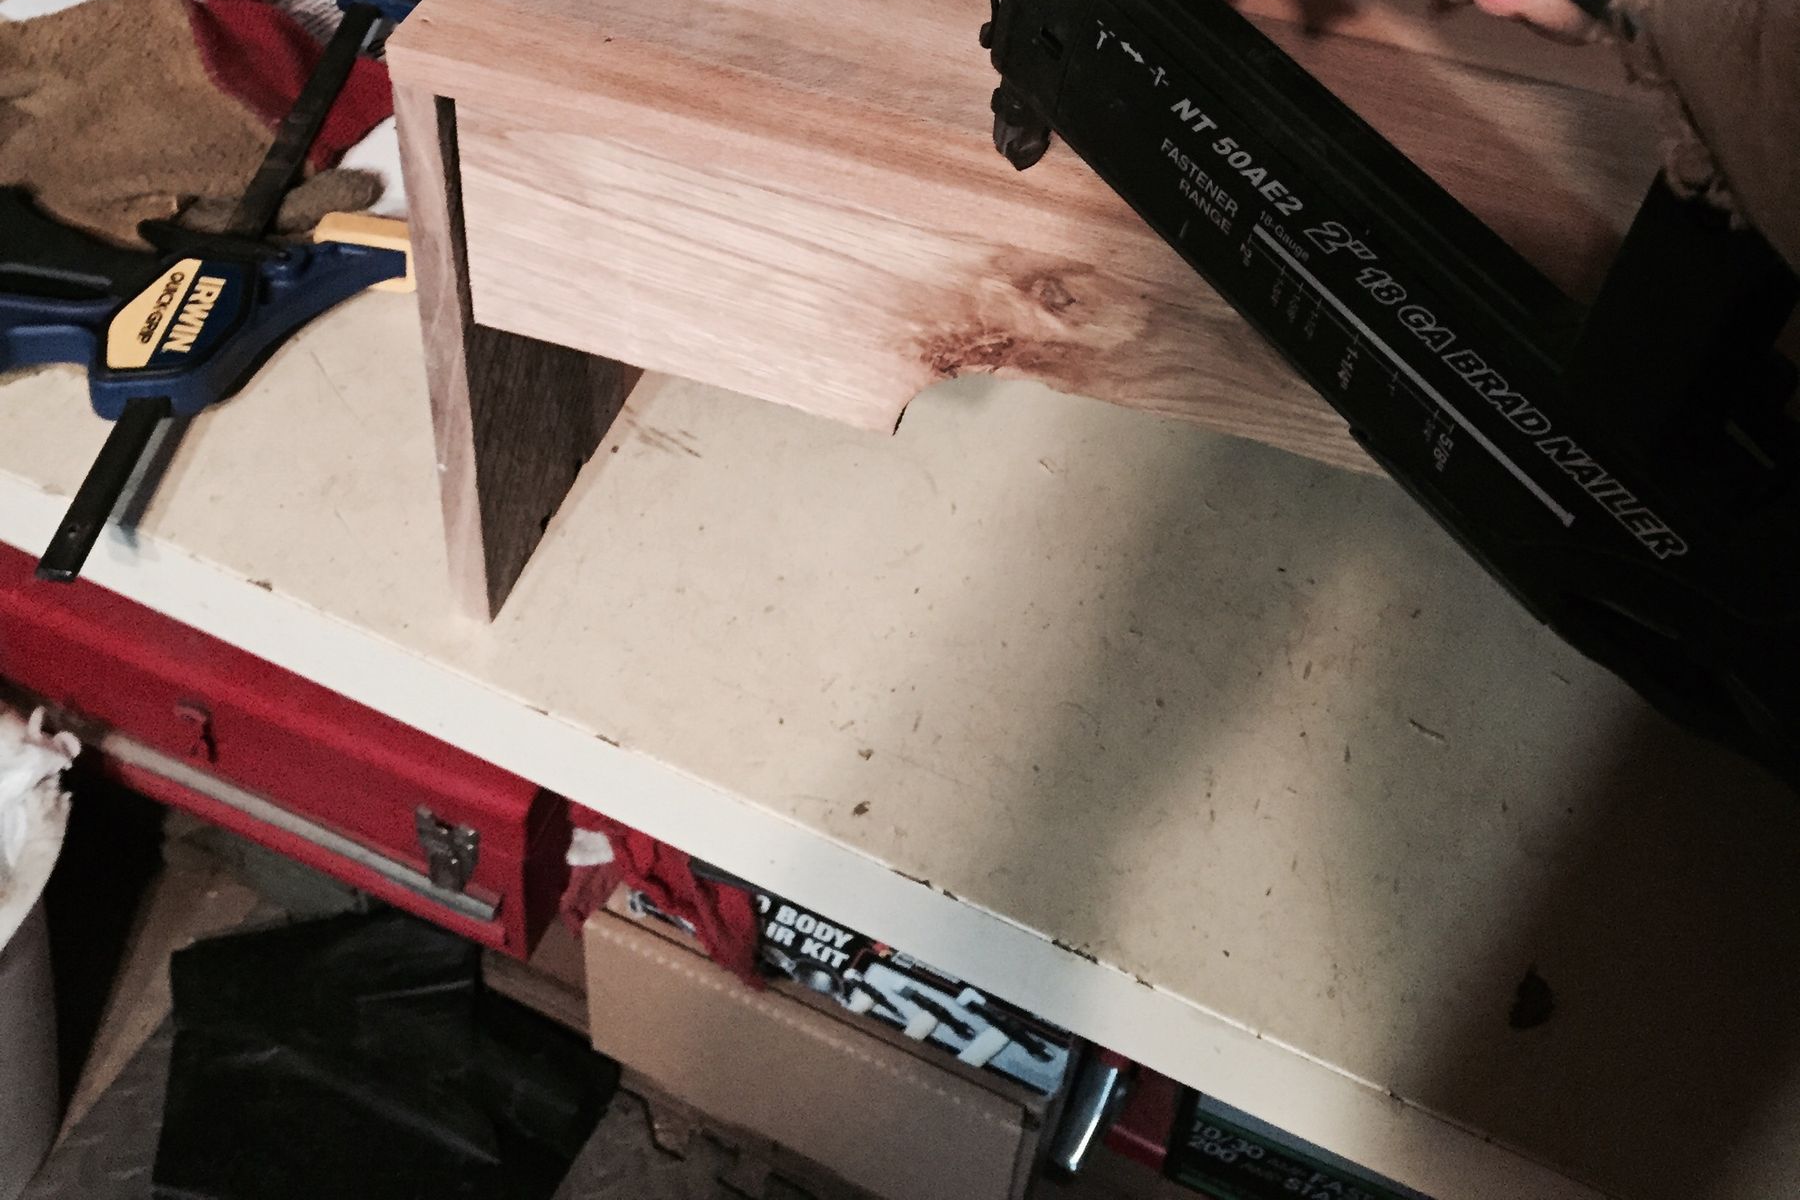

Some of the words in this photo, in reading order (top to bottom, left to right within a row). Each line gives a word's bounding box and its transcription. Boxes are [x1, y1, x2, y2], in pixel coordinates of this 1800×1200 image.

[1160, 137, 1239, 219] FASTENER
[1170, 98, 1218, 133] NT
[1211, 136, 1303, 217] 50AE2
[1179, 178, 1232, 235] RANGE
[1258, 210, 1311, 263] 18-Gauge
[161, 275, 227, 353] IRWIN
[1355, 267, 1408, 305] 18
[1397, 305, 1457, 353] GA
[1441, 349, 1552, 435] BRAD
[1535, 436, 1689, 560] NAILER
[775, 904, 853, 949] BODY
[800, 936, 850, 969] KIT
[1187, 1135, 1239, 1162] 200
